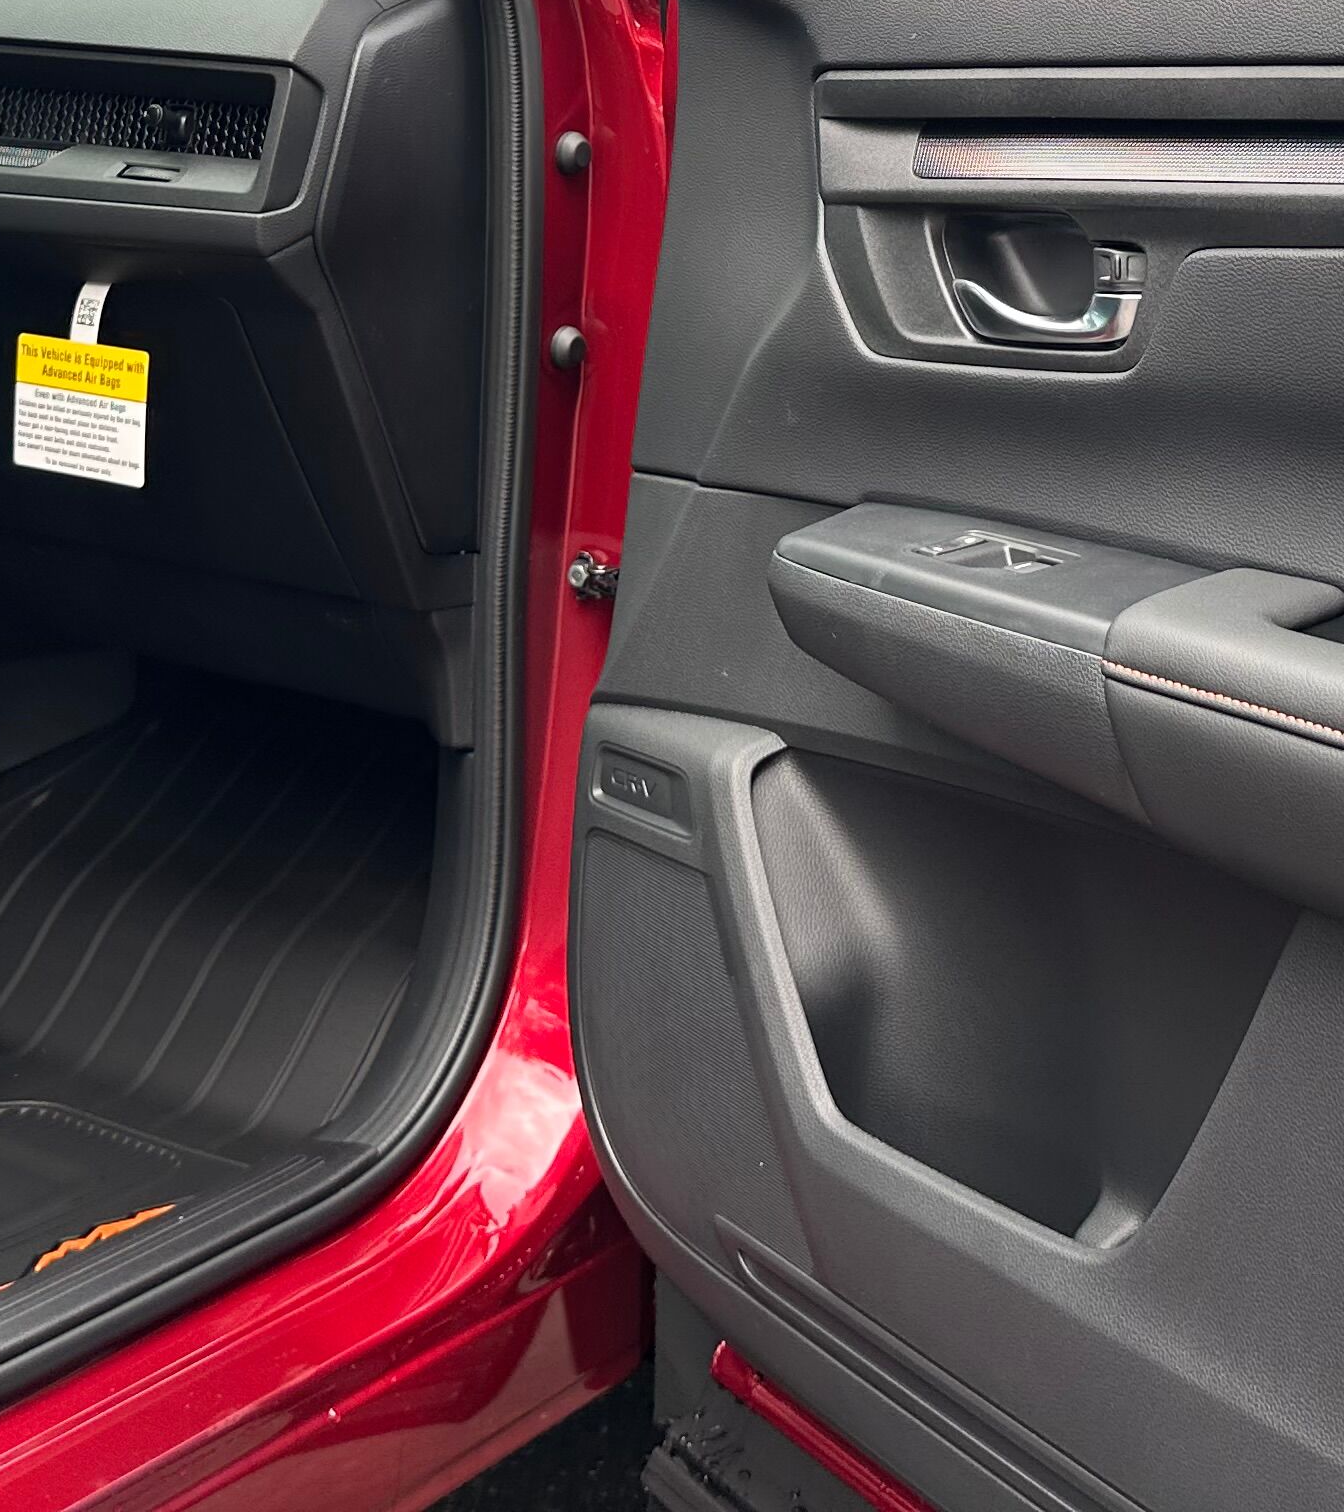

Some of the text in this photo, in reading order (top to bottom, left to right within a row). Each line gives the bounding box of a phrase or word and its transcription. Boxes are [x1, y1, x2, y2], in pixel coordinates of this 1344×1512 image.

[21, 344, 145, 374] This Vehicle is Equipped with
[42, 365, 121, 390] Advanced Air Bags
